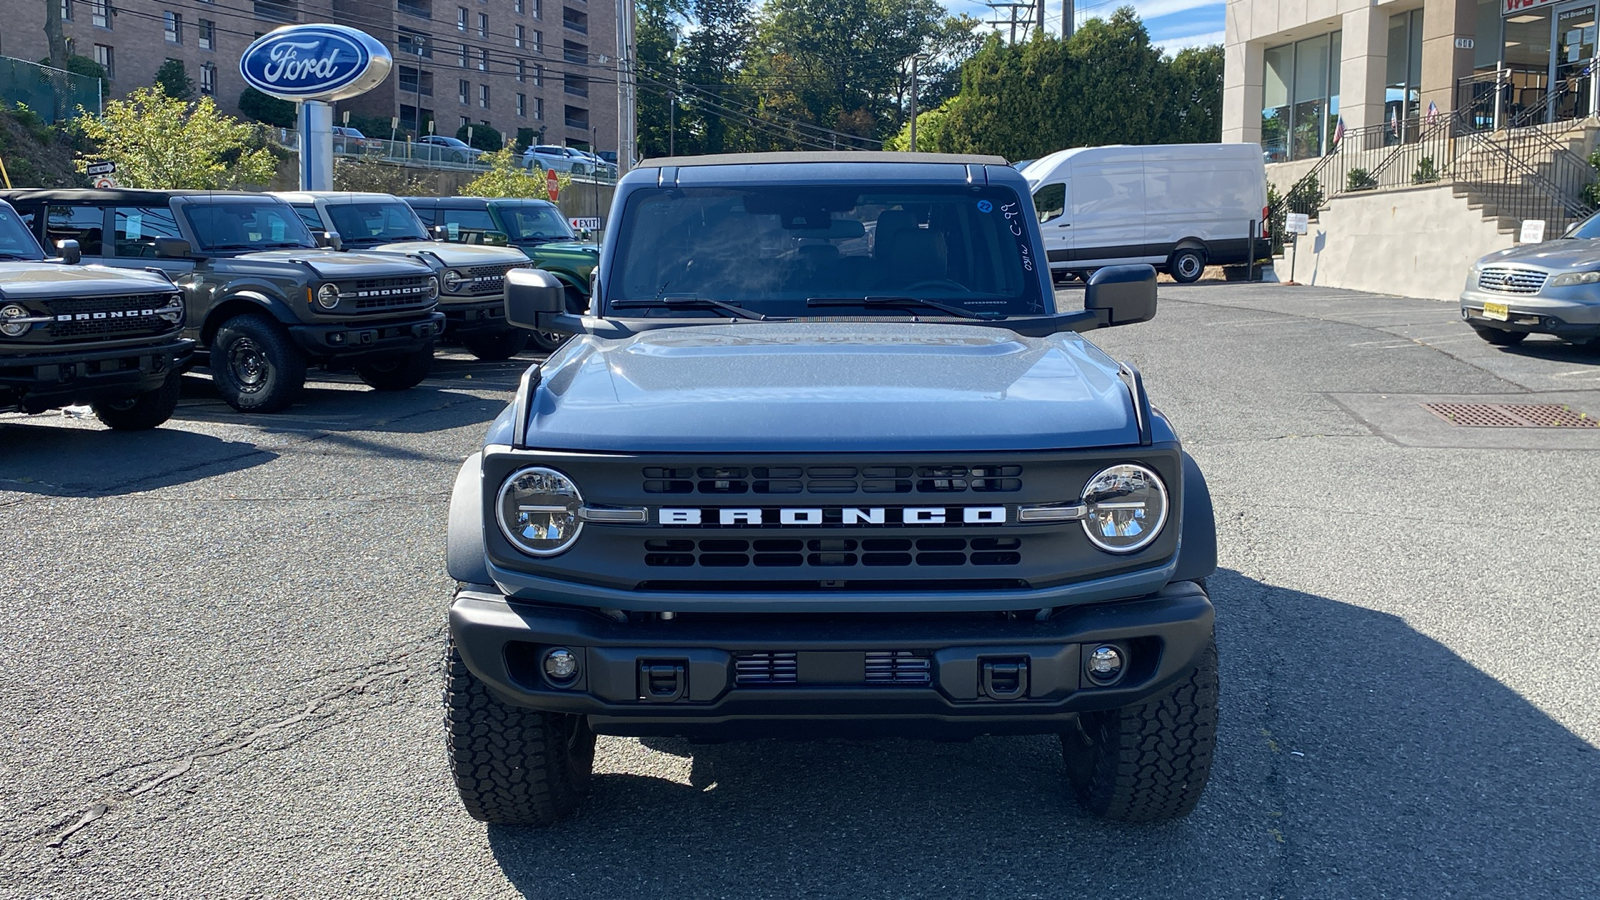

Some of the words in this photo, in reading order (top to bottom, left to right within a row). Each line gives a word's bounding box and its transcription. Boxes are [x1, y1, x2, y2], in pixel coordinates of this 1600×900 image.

[1570, 8, 1586, 18] Broad
[264, 41, 340, 83] Ford
[980, 202, 991, 211] 22
[580, 220, 597, 228] EXIT
[358, 288, 420, 296] BRONCO
[57, 309, 153, 321] BRONCO
[658, 508, 1006, 524] BRONCO
